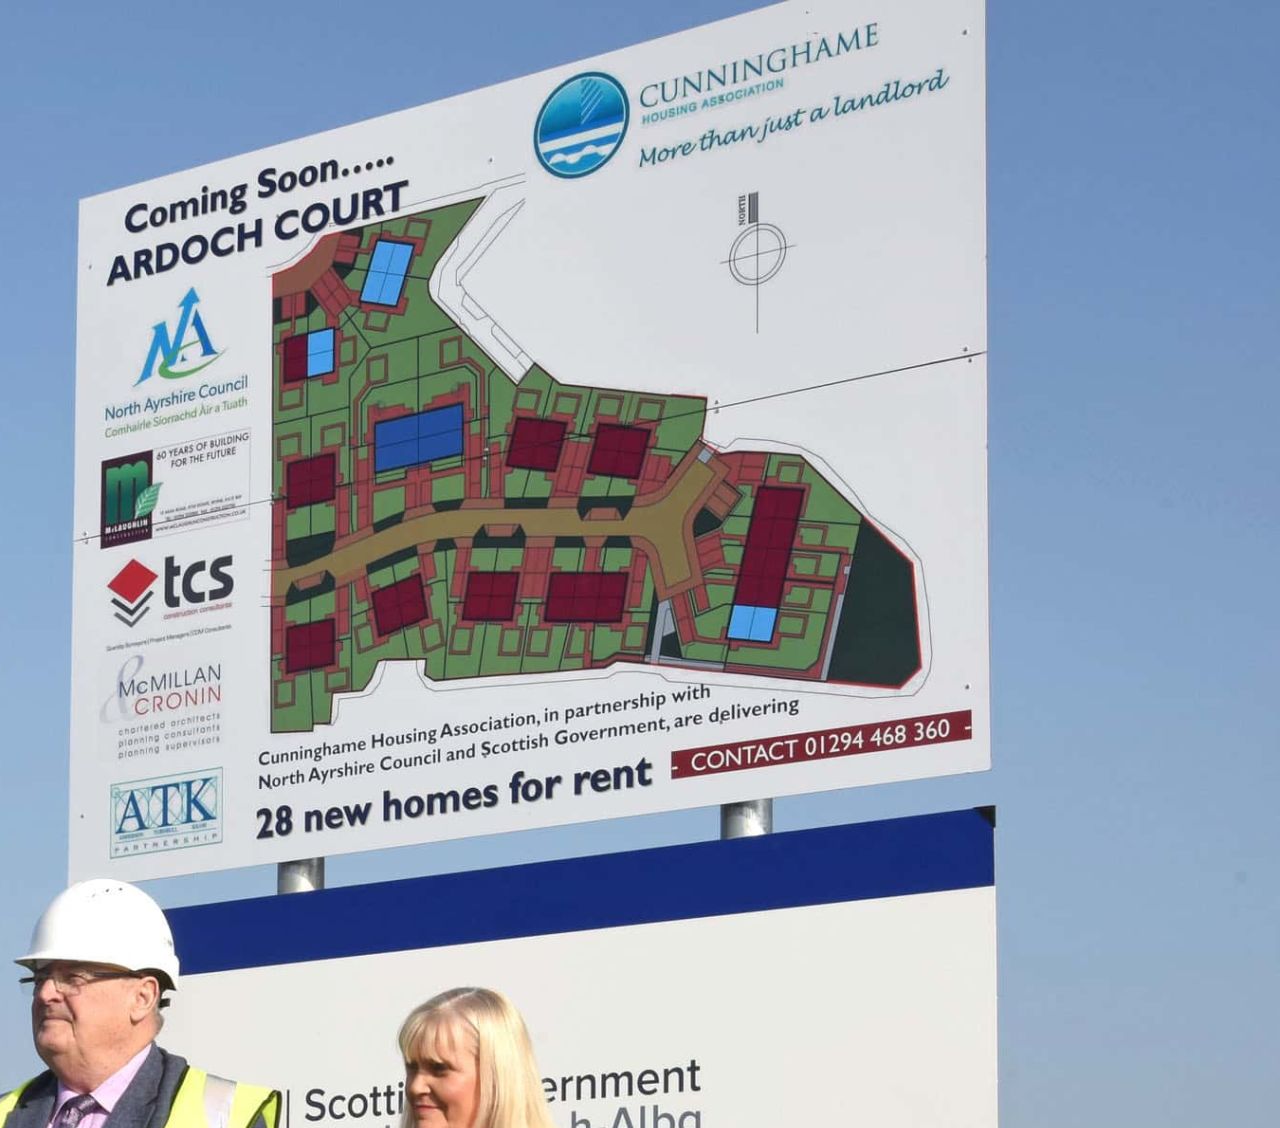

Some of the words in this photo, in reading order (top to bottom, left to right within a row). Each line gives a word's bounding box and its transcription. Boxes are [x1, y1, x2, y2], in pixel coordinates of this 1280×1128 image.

[639, 22, 880, 109] CUNNINGHAME
[638, 140, 696, 168] More
[695, 125, 759, 154] than
[757, 107, 807, 145] just
[809, 105, 831, 122] a
[831, 68, 950, 116] landlord
[641, 100, 698, 125] HOUSING
[701, 77, 785, 110] ASSOCIATION
[106, 218, 263, 286] ARDOCH
[274, 180, 409, 240] COURT
[124, 183, 248, 233] Coming
[105, 402, 141, 421] North
[144, 390, 196, 413] Ayrshire
[198, 375, 249, 399] Council
[105, 418, 152, 438] Comhairle
[221, 396, 249, 411] Tuath
[169, 445, 194, 458] YEARS
[196, 442, 208, 452] OF
[210, 432, 250, 449] BUILDING
[171, 458, 187, 469] FOR
[189, 454, 204, 465] THE
[206, 446, 237, 461] FUTURE
[164, 554, 235, 608] tcs
[119, 663, 221, 698] McMILLAN
[134, 685, 222, 716] CRONIN
[118, 721, 166, 736] chartered
[170, 712, 221, 727] architects
[118, 733, 160, 749] planning
[164, 724, 221, 740] consultants
[118, 745, 160, 760] planning
[166, 736, 221, 751] supervisors
[258, 737, 367, 767] Cunninghame
[370, 725, 438, 749] Housing
[440, 710, 541, 739] Association,
[544, 707, 560, 723] in
[564, 690, 667, 724] partnership
[672, 684, 711, 702] with
[258, 768, 305, 790] North
[308, 759, 375, 784] Ayrshire
[379, 748, 441, 772] Council
[445, 743, 476, 761] and
[481, 733, 550, 758] Scottish
[554, 718, 670, 746] Government,
[674, 713, 703, 729] are
[708, 697, 800, 725] delivering
[690, 738, 799, 772] CONTACT
[804, 727, 864, 757] 01294
[870, 723, 907, 745] 468
[913, 717, 951, 740] 360
[115, 777, 218, 834] ATK
[256, 804, 293, 839] 28
[303, 801, 372, 833] new
[382, 783, 499, 822] homes
[509, 770, 562, 804] for
[573, 757, 653, 796] rent
[304, 1081, 404, 1122] Scotti
[541, 1059, 702, 1104] ernment
